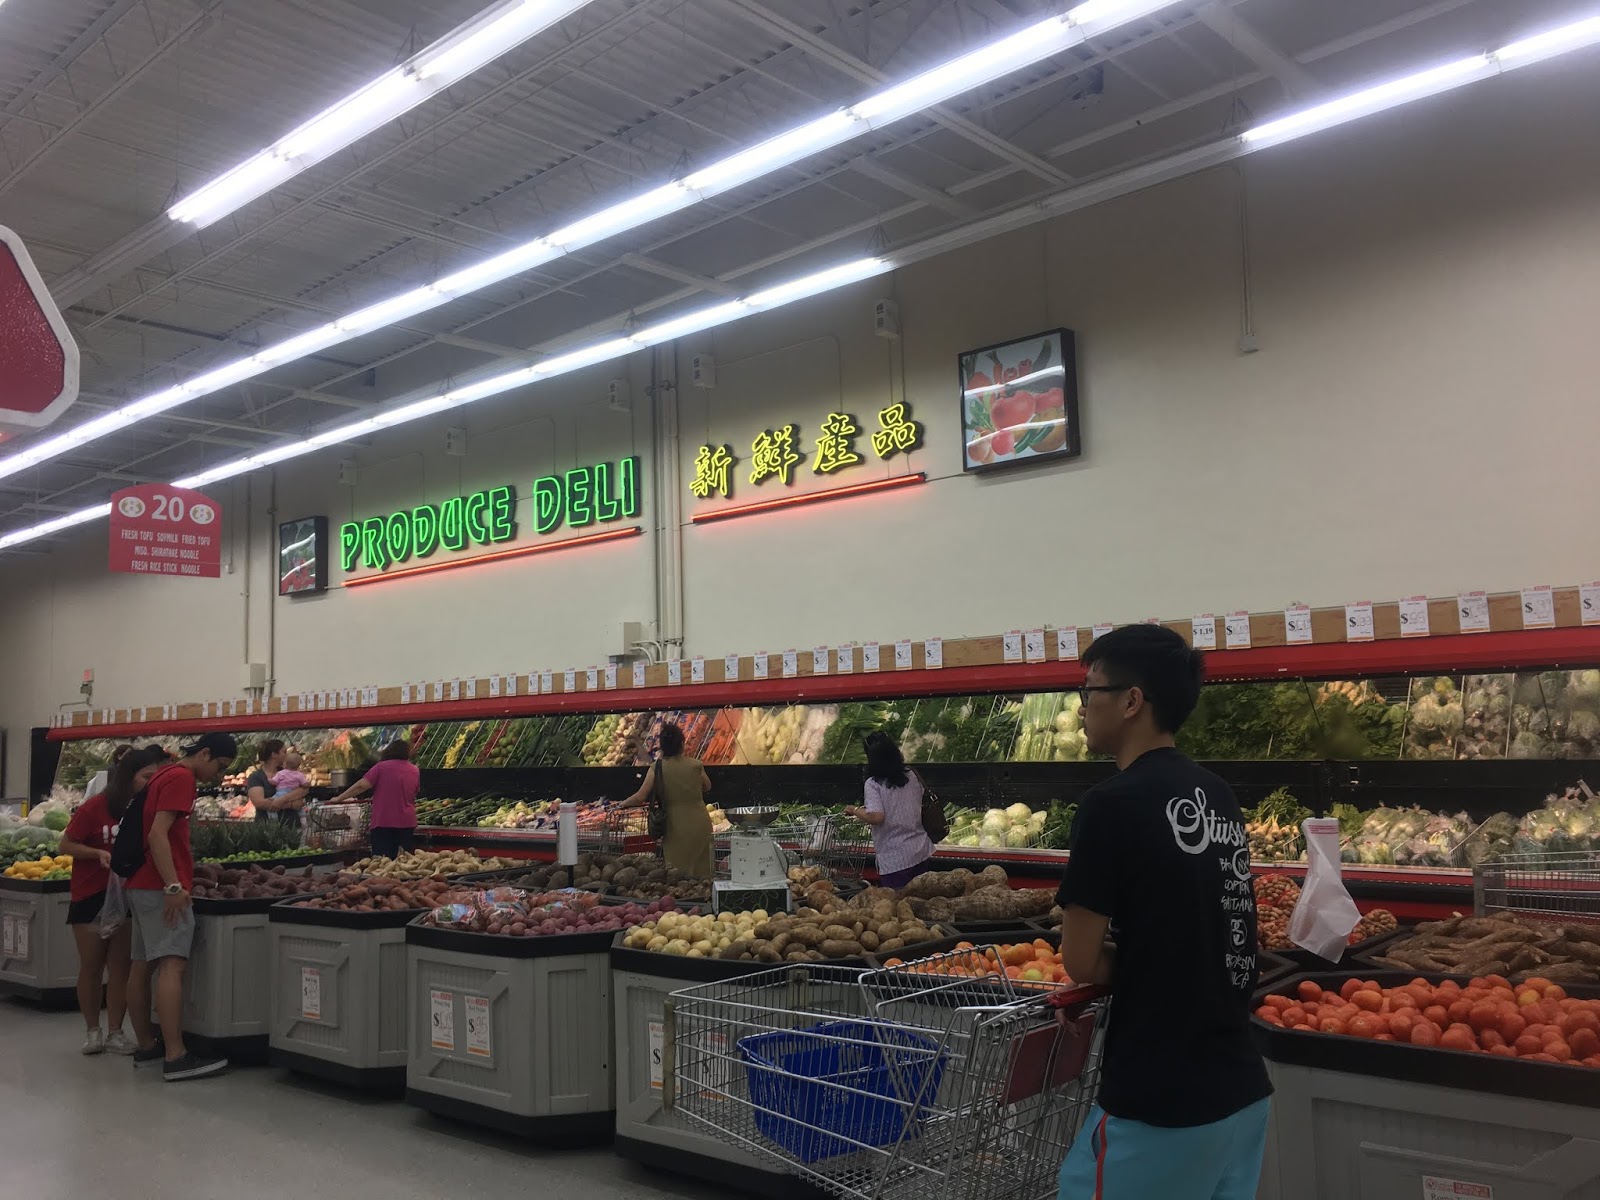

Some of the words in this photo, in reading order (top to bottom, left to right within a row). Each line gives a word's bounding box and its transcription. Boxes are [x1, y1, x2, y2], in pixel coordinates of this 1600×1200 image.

[151, 494, 185, 522] 20
[340, 486, 514, 571] PRODUCE
[533, 456, 639, 534] DELI
[121, 529, 138, 540] FRESH
[140, 531, 154, 541] TOFU
[157, 532, 178, 543] SOYMILK
[182, 534, 196, 545] FRIED
[197, 536, 211, 546] TOFU
[180, 549, 200, 560] NOODLE
[131, 560, 148, 571] FRESH
[149, 562, 161, 572] RICE
[163, 562, 178, 573] STICK
[180, 563, 200, 574] NOODLE
